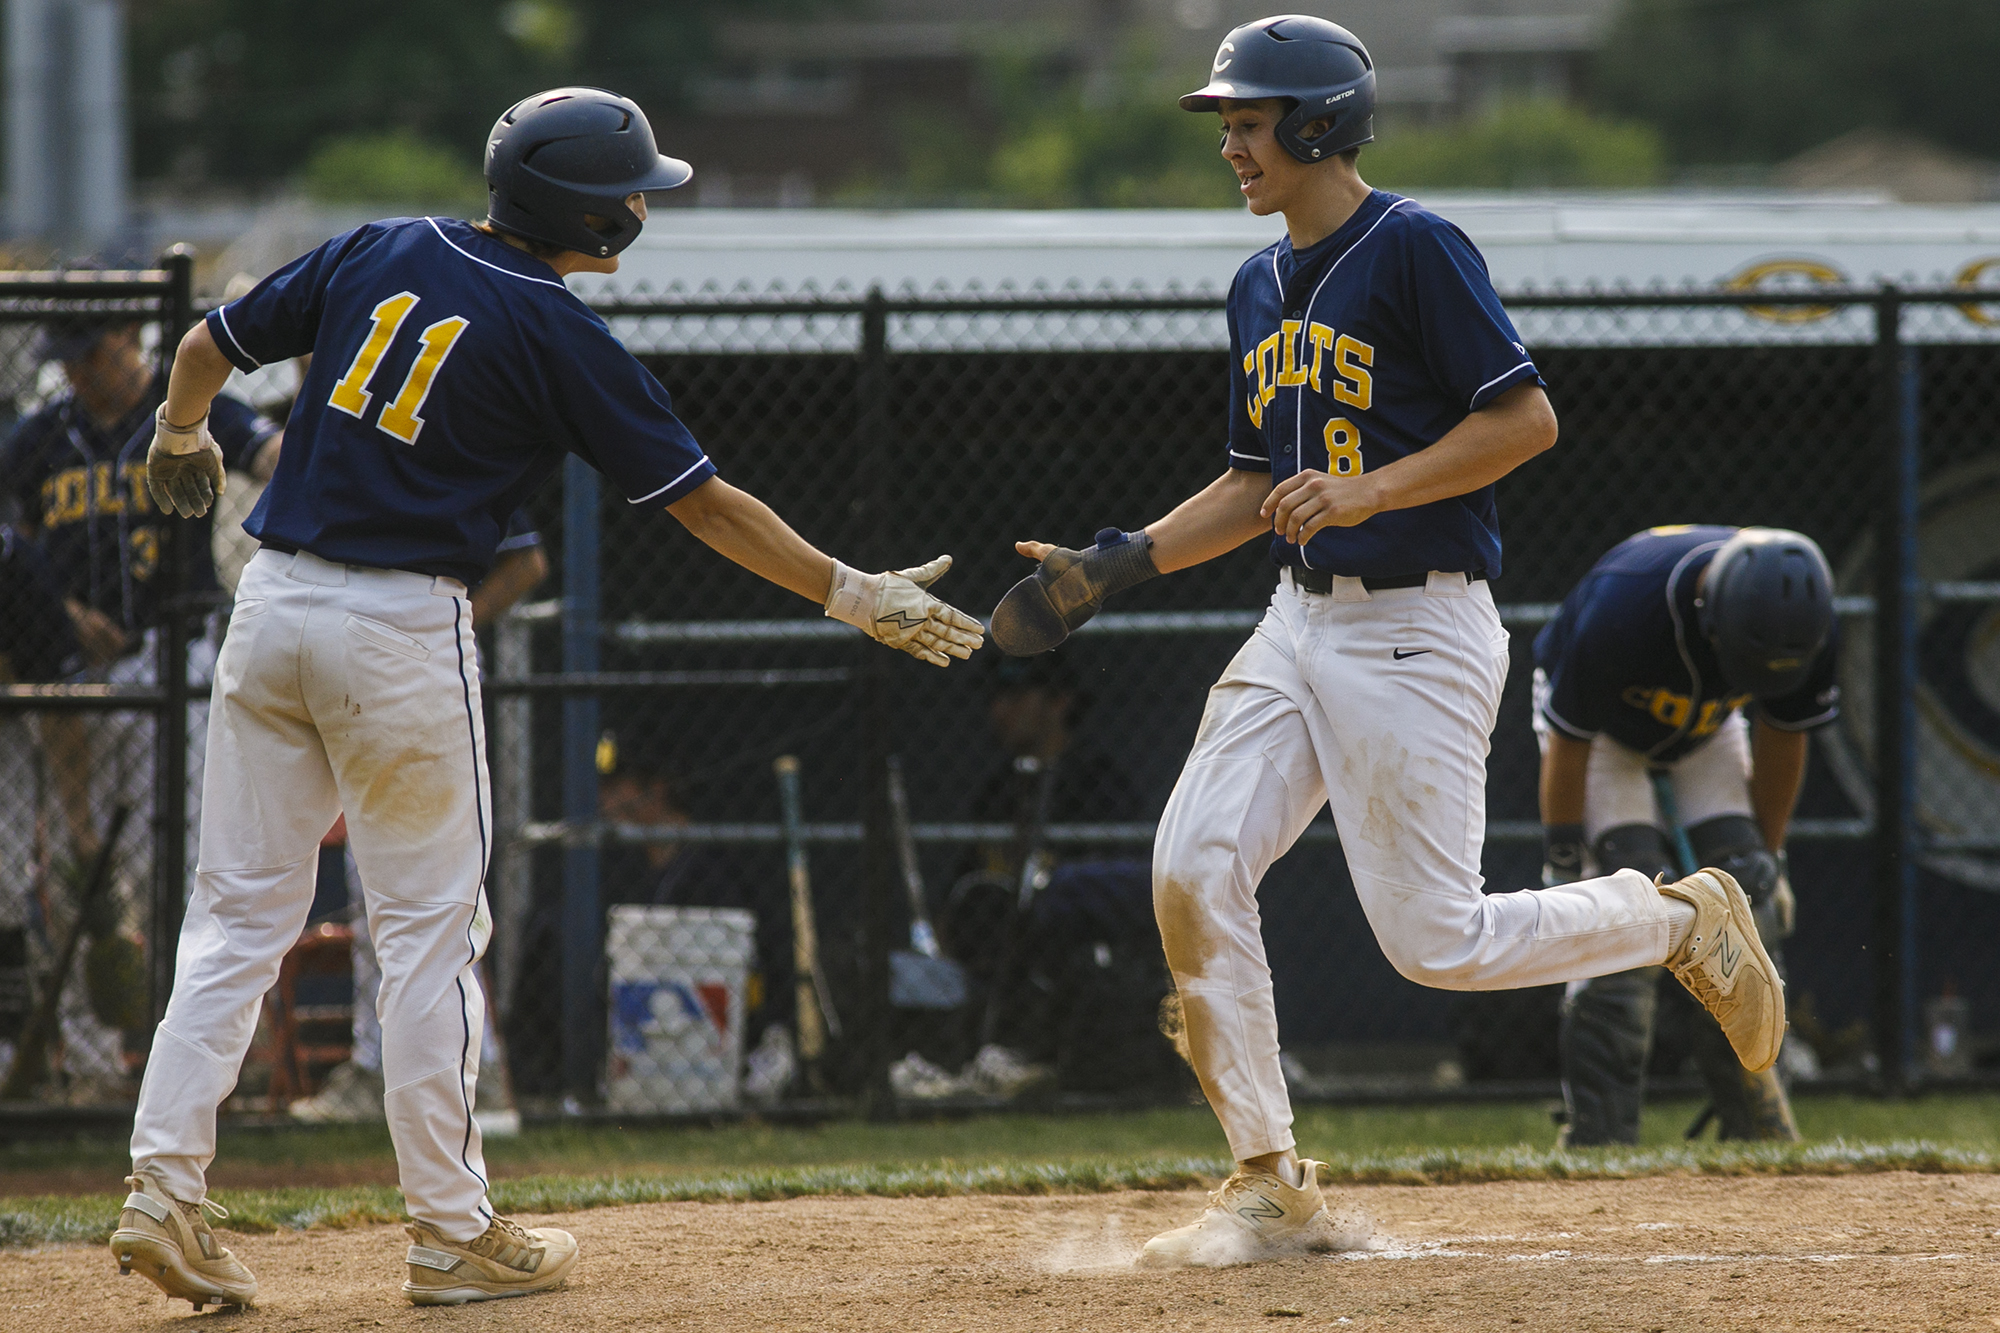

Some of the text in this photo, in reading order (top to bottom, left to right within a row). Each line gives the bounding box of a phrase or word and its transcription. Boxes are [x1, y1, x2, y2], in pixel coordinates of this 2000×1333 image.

[1213, 42, 1235, 73] C
[1325, 88, 1355, 105] EASTON
[327, 290, 470, 446] 11
[1243, 319, 1374, 429] COLTS
[1323, 417, 1363, 477] 8
[41, 461, 150, 529] COLT
[410, 1255, 438, 1265] ICON
